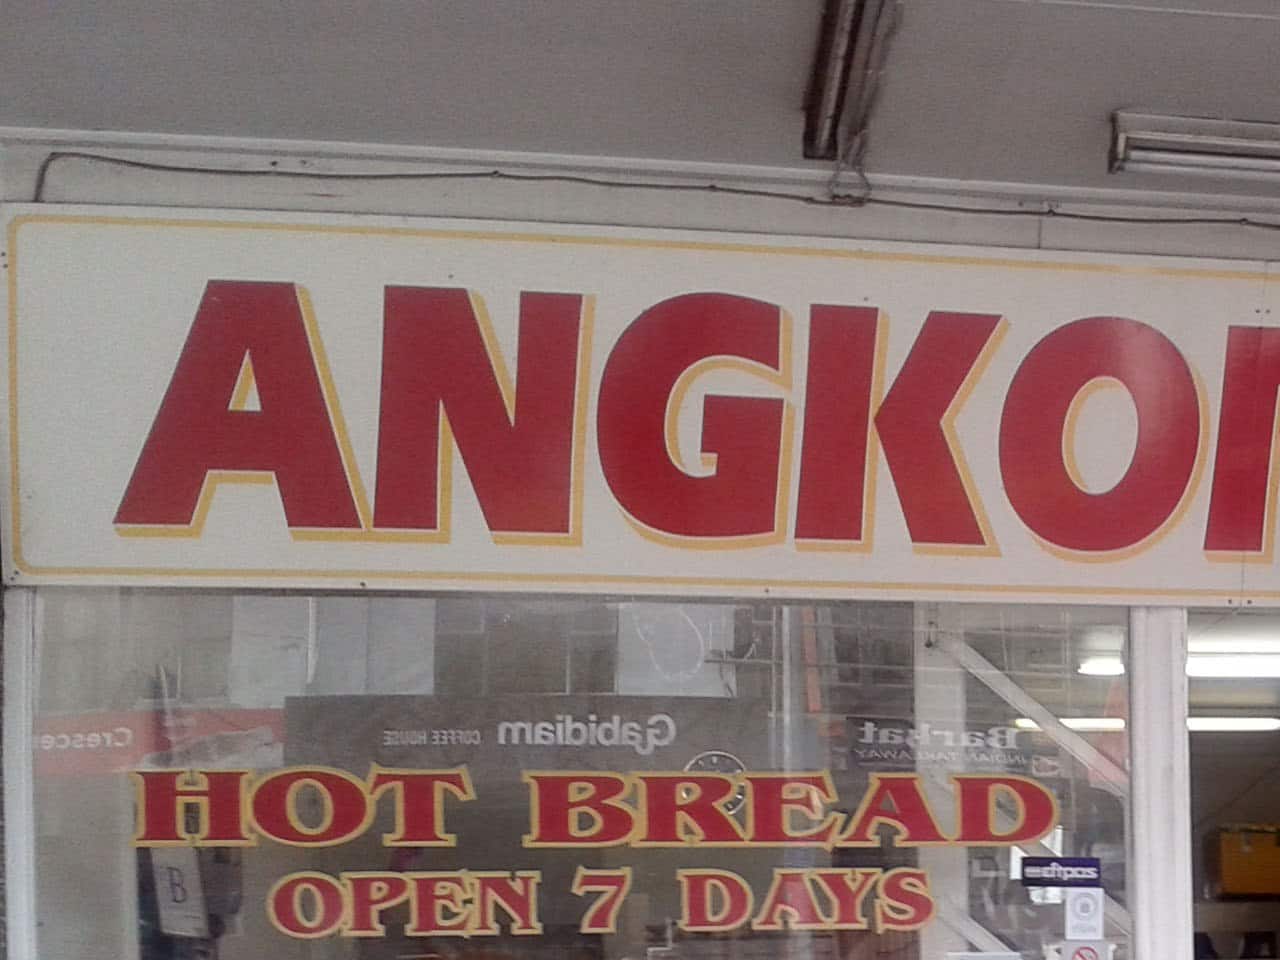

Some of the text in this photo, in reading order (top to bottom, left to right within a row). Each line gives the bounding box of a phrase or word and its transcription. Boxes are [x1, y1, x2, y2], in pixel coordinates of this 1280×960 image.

[132, 763, 1059, 852] HOT BREAD
[266, 866, 937, 939] OPEN 7 DAYS
